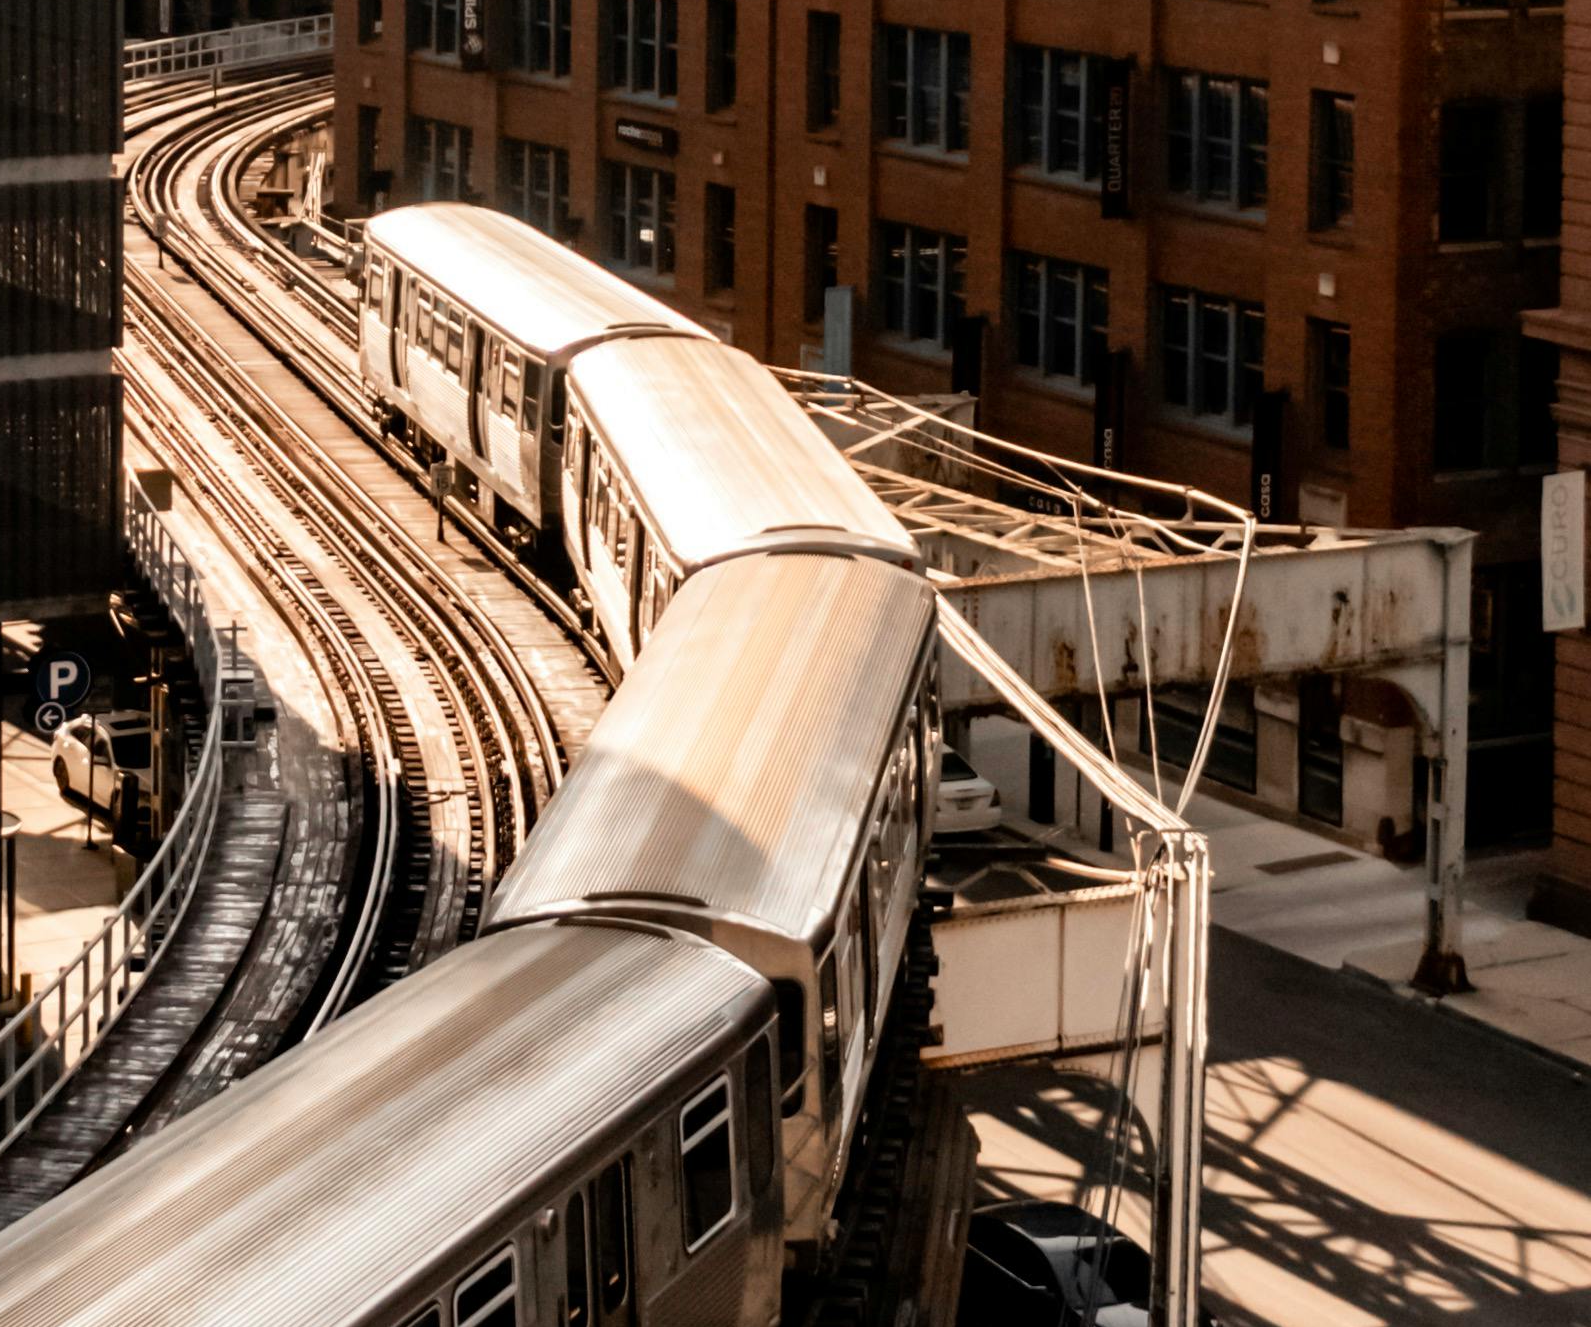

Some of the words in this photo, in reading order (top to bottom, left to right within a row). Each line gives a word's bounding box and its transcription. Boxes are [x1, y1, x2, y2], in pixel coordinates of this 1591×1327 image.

[1260, 474, 1271, 518] casa
[1550, 485, 1569, 581] CURO
[50, 660, 78, 699] P
